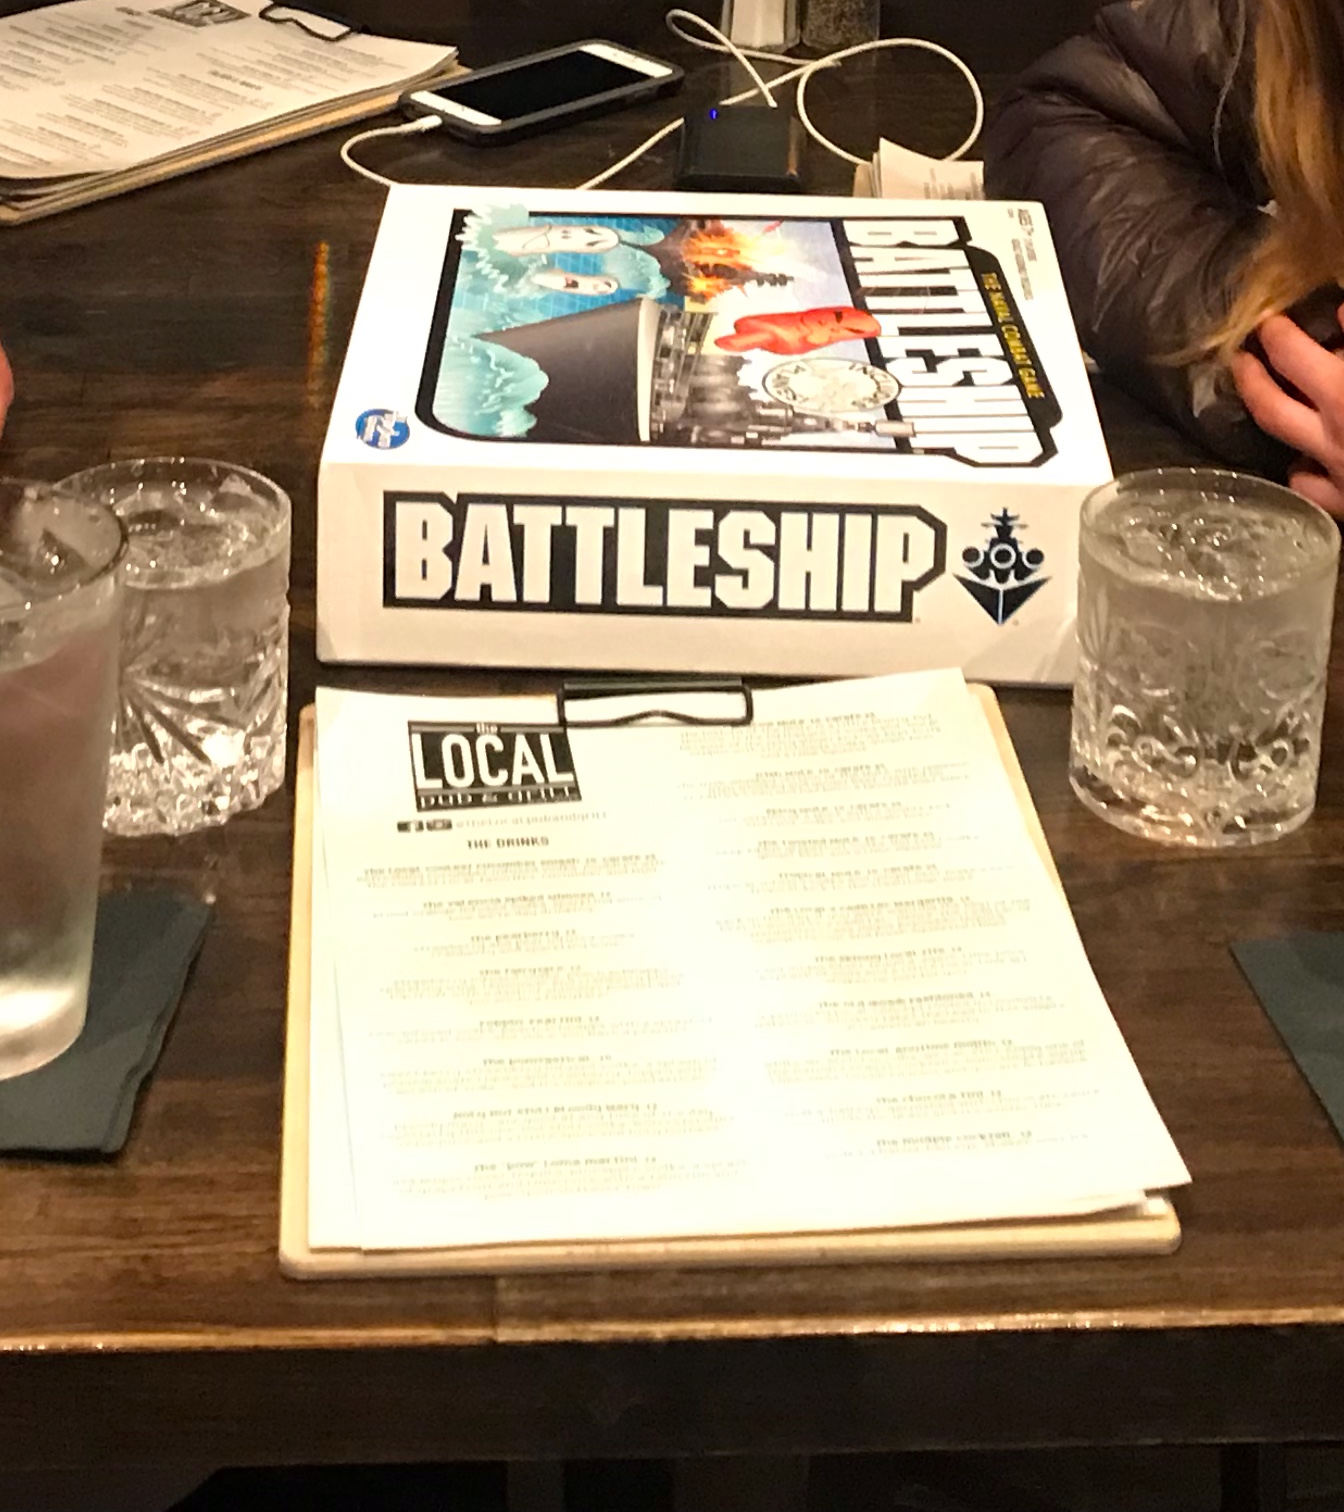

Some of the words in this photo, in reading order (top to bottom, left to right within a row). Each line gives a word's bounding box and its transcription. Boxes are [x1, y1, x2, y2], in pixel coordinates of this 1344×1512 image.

[843, 219, 1044, 464] BATTLESHIP
[394, 500, 934, 613] BATTLESHIP
[411, 732, 575, 790] LOCAL
[467, 838, 492, 850] THE
[496, 836, 550, 849] DRINKS
